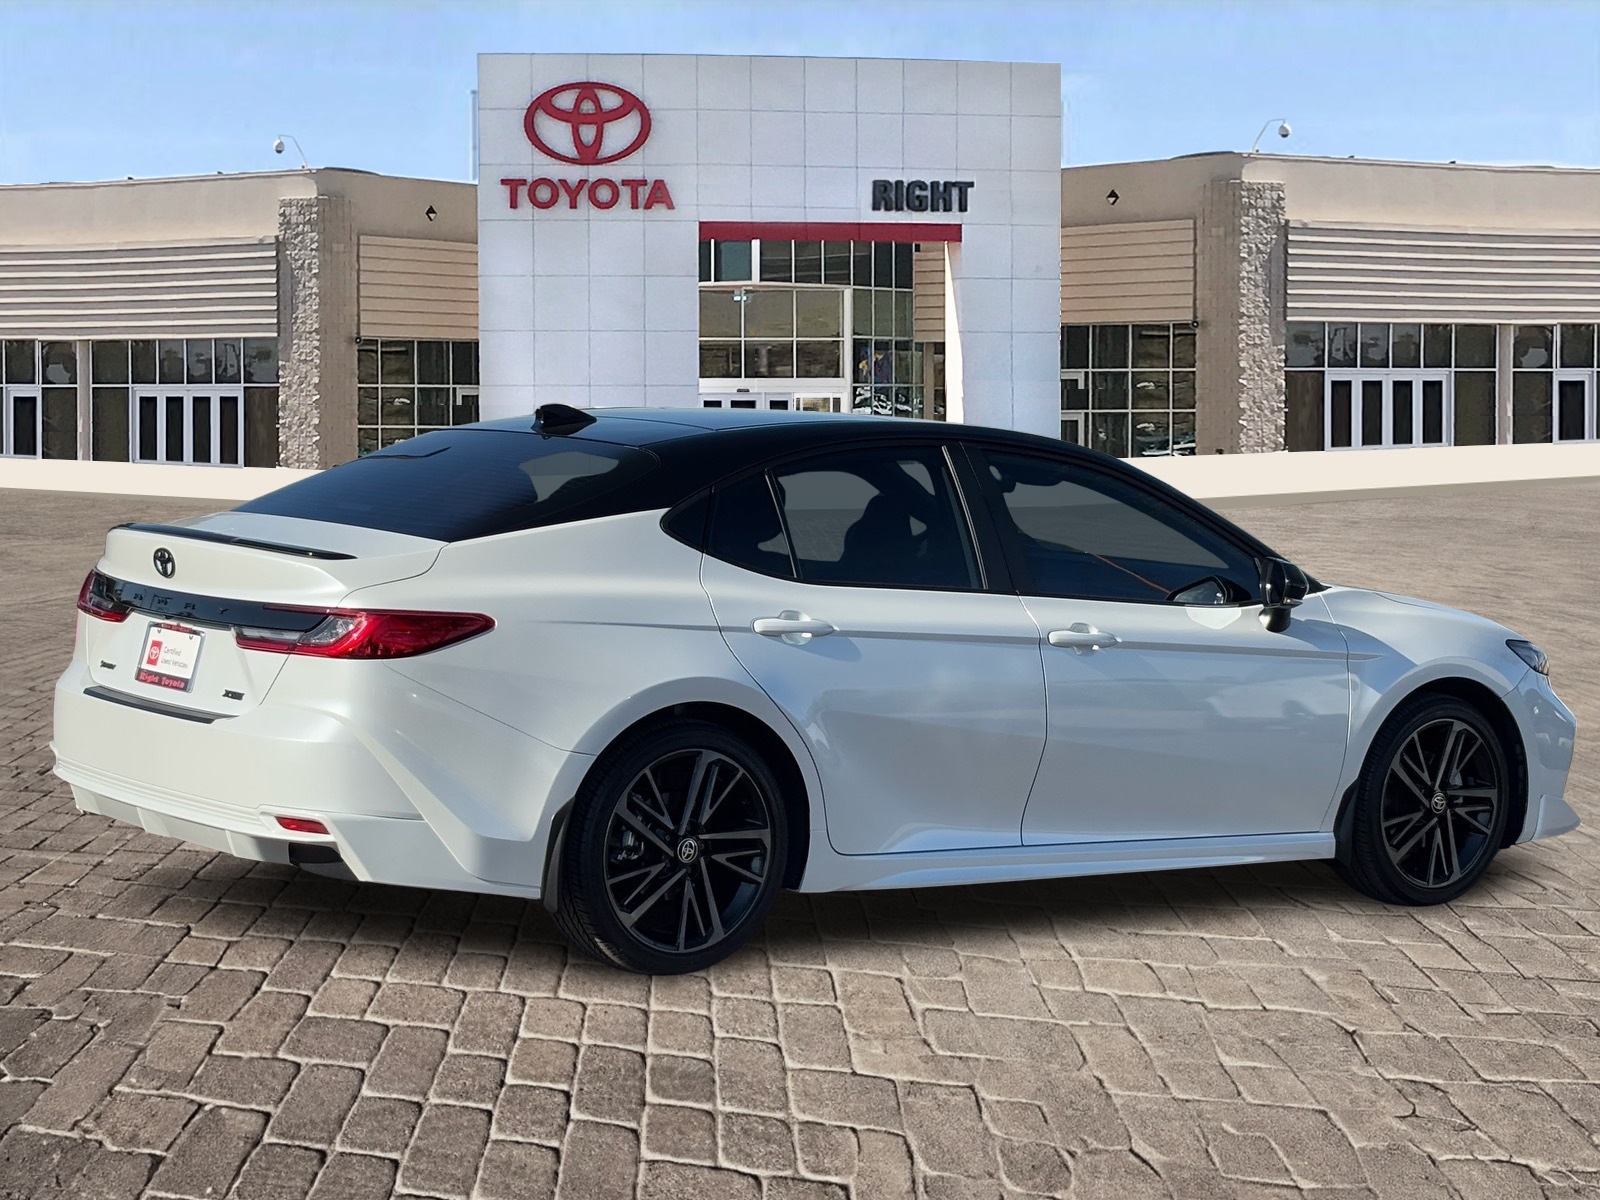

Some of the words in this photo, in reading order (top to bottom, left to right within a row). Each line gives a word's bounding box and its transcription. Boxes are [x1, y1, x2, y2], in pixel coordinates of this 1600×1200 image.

[500, 178, 675, 210] TOYOTA
[872, 179, 975, 213] RIGHT
[139, 670, 159, 683] Right
[161, 677, 185, 688] Toyota
